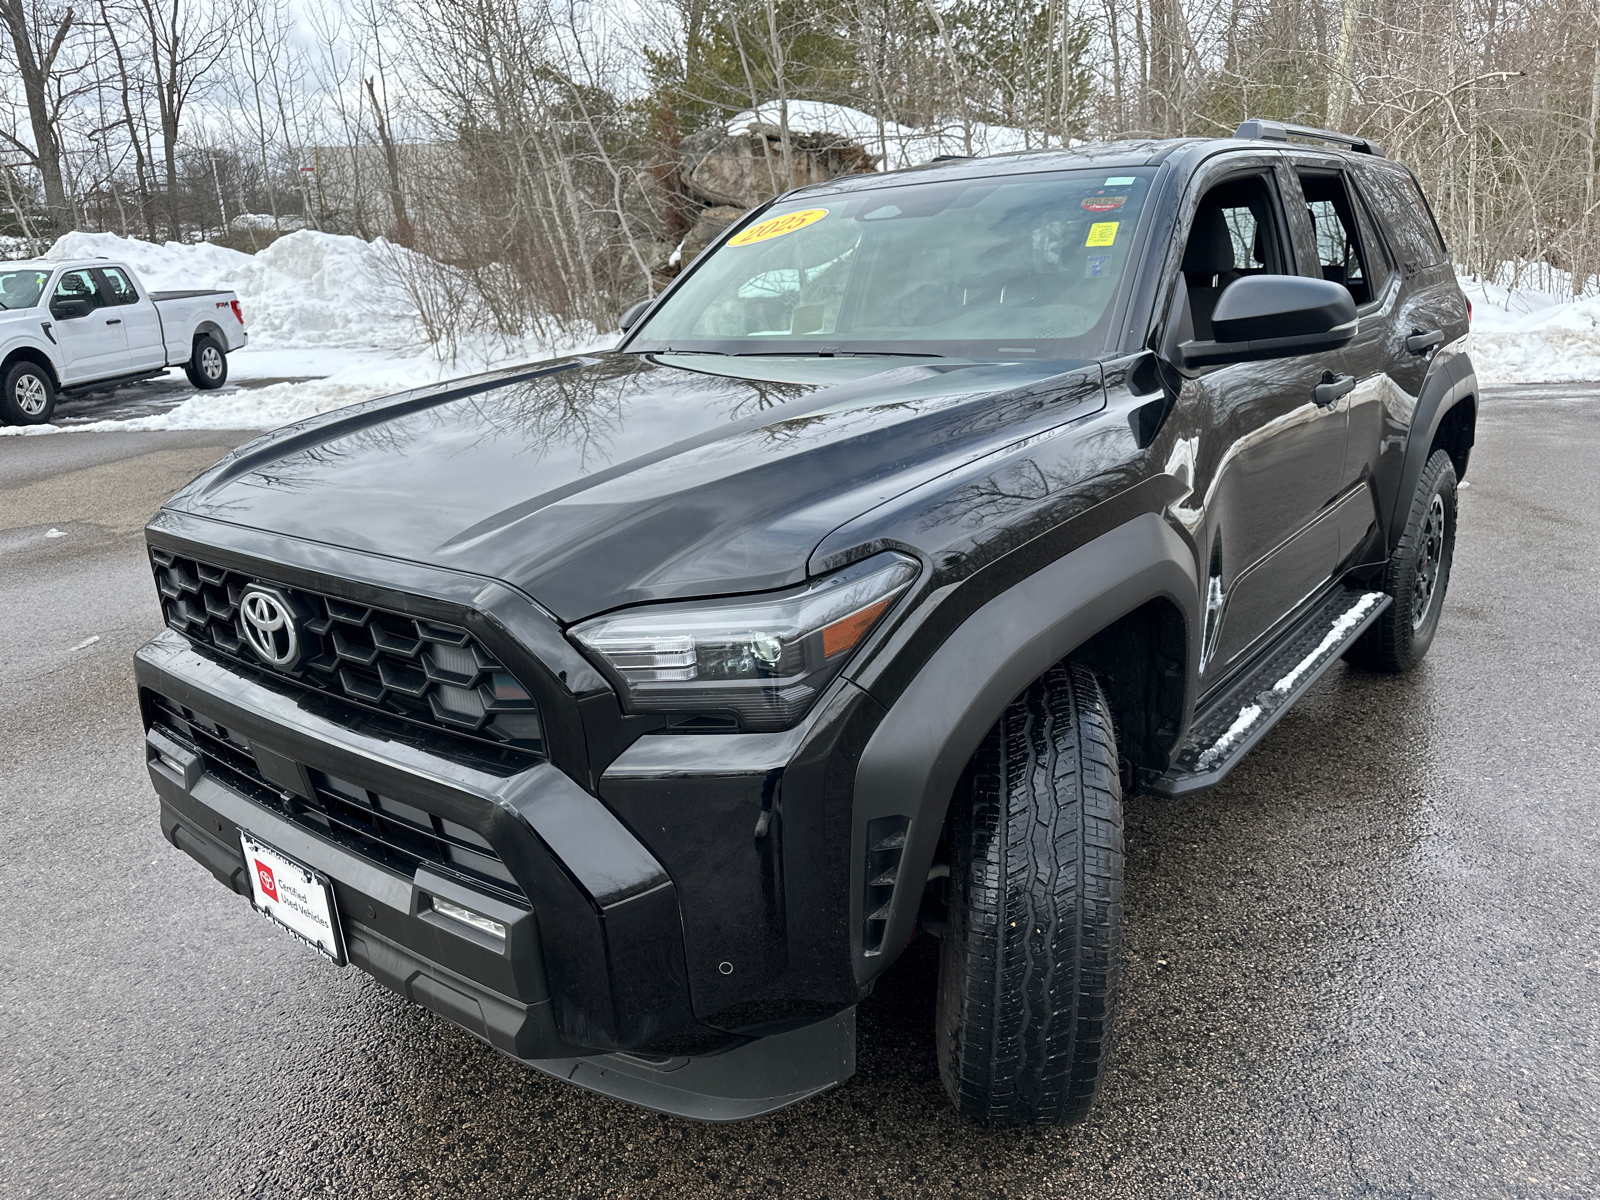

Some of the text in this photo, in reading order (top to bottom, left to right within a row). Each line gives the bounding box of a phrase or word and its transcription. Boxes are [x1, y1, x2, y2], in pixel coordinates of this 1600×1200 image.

[738, 211, 815, 244] 2025
[278, 878, 308, 904] Certified
[280, 892, 299, 911] Used
[298, 903, 329, 929] Vehicles
